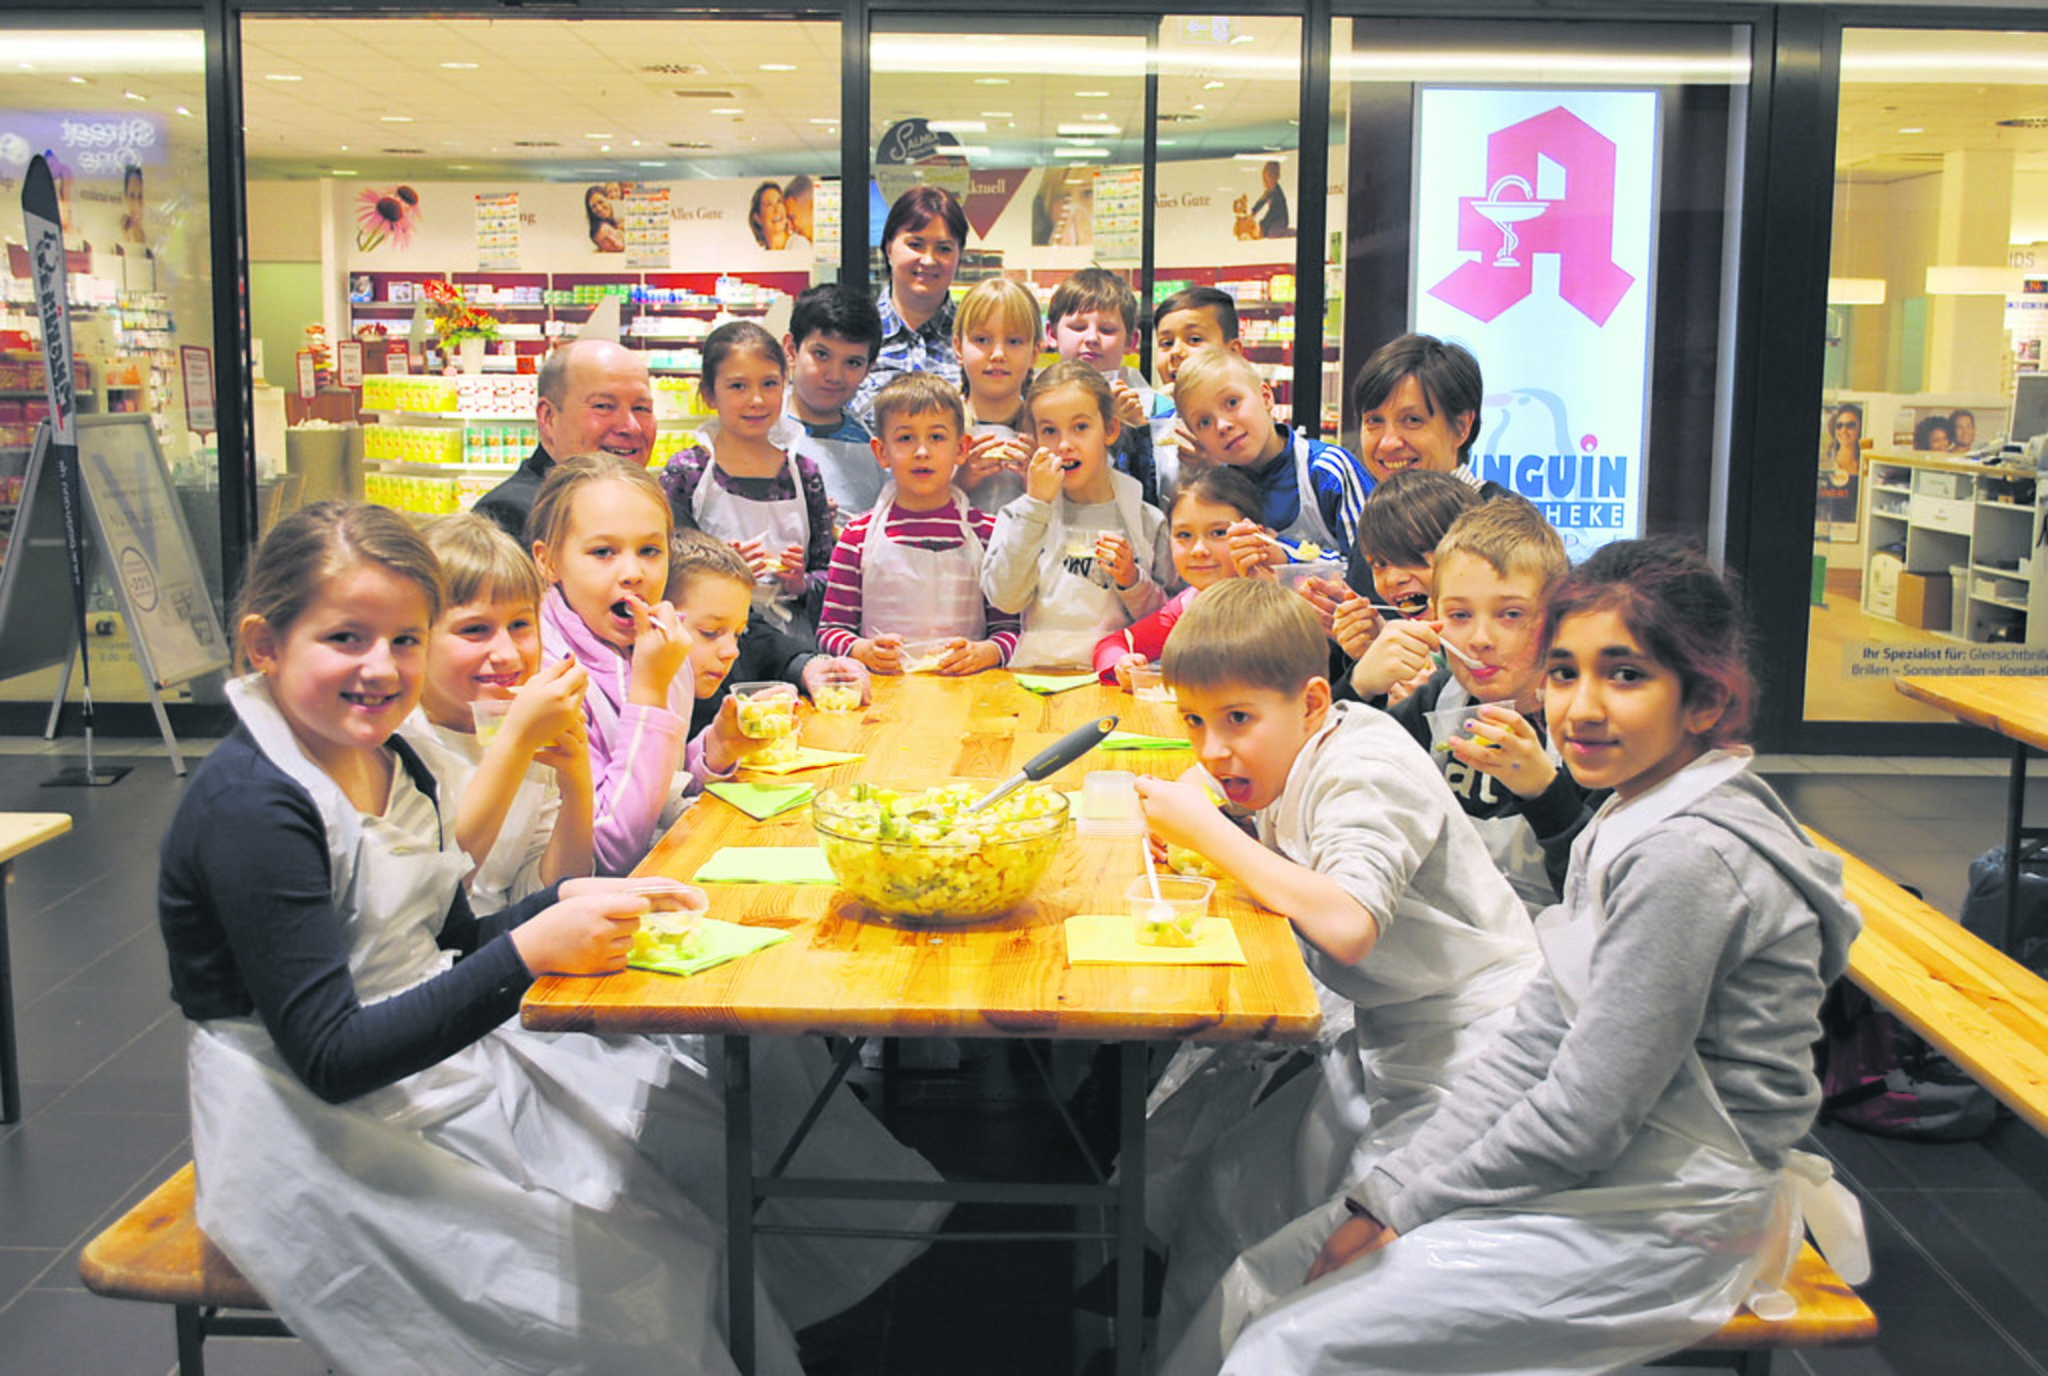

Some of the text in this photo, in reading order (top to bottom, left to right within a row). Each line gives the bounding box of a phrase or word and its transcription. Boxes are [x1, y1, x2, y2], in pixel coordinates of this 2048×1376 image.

[1181, 191, 1211, 207] Gute
[1863, 647, 1880, 659] Ihr
[1883, 647, 1941, 662] Spezialist
[1945, 647, 1967, 660] für:
[1852, 664, 1889, 675] Brillen
[1903, 664, 1985, 676] Sonnenbrillen
